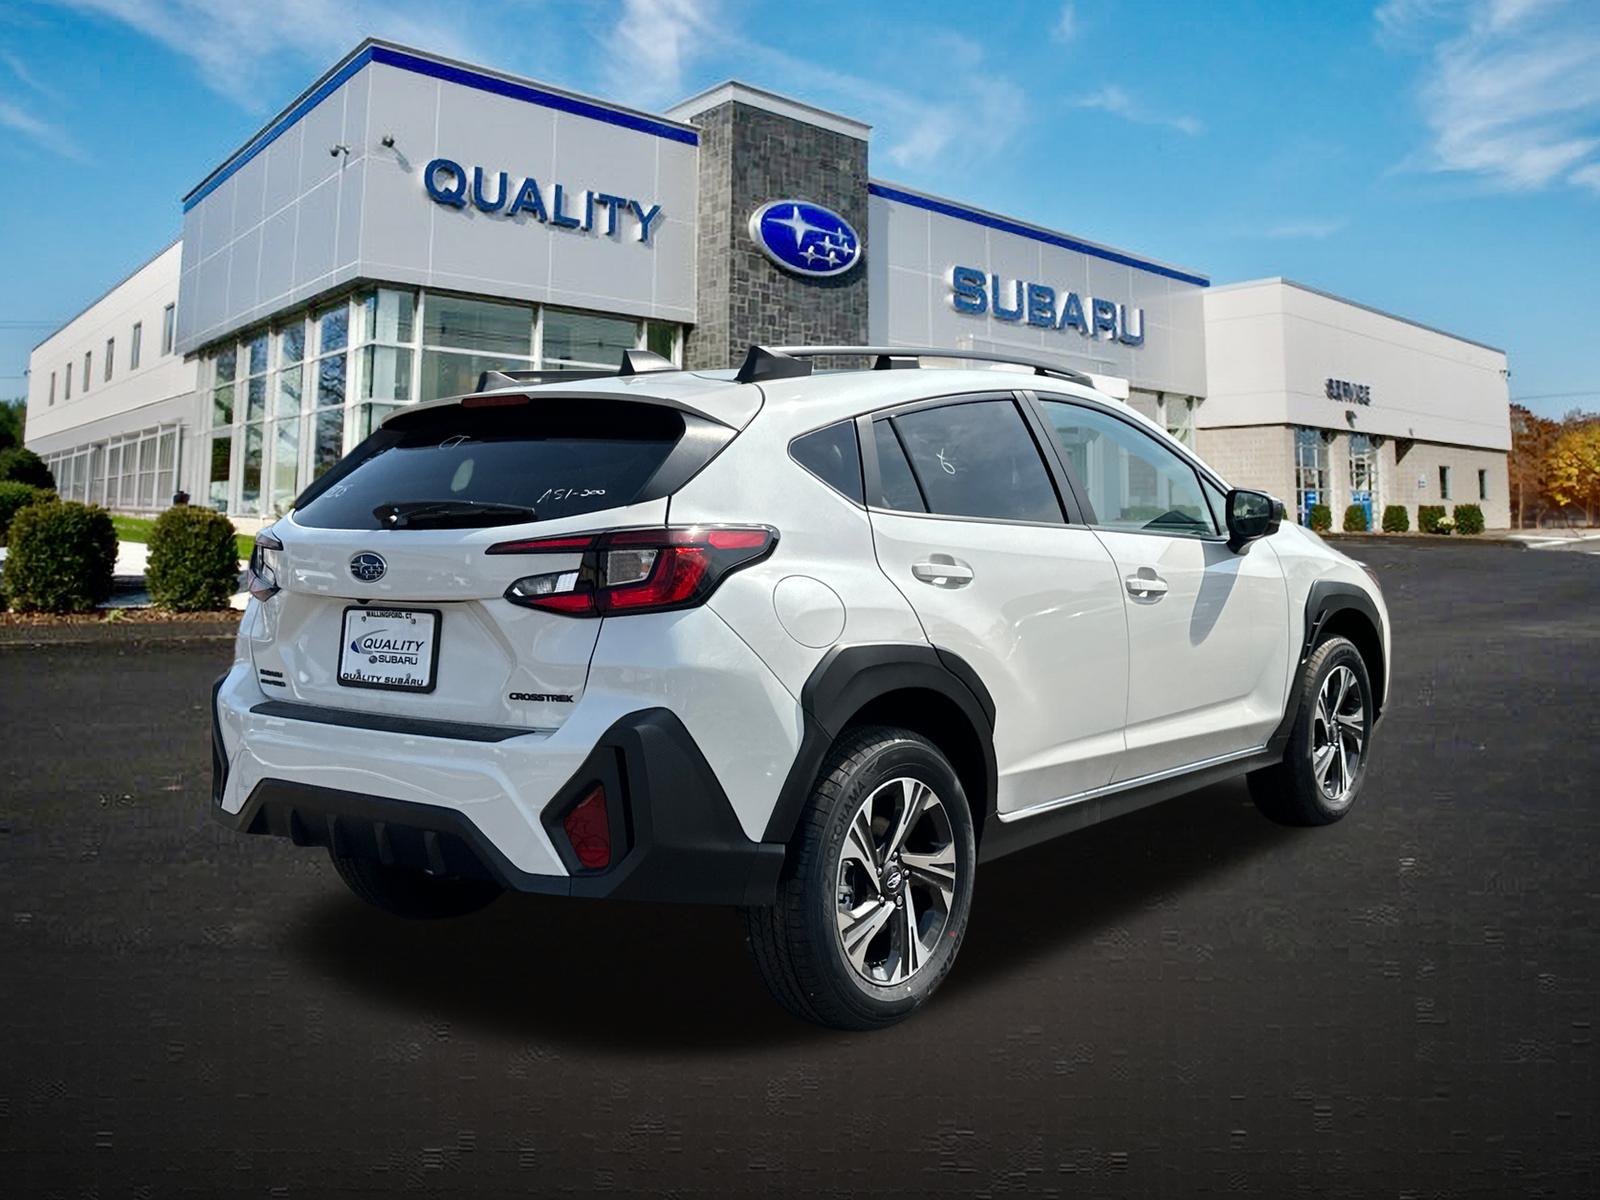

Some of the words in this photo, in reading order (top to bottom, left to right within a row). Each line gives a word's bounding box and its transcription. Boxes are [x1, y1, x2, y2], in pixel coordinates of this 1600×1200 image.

[423, 157, 661, 243] QUALITY
[950, 264, 1145, 347] SUBARU
[1325, 378, 1371, 406] SERVICE
[363, 637, 425, 652] QUALITY
[378, 654, 418, 666] SUBARU
[342, 672, 382, 683] QUALITY
[384, 675, 424, 687] SUBARU
[508, 692, 574, 703] CROSSTREK
